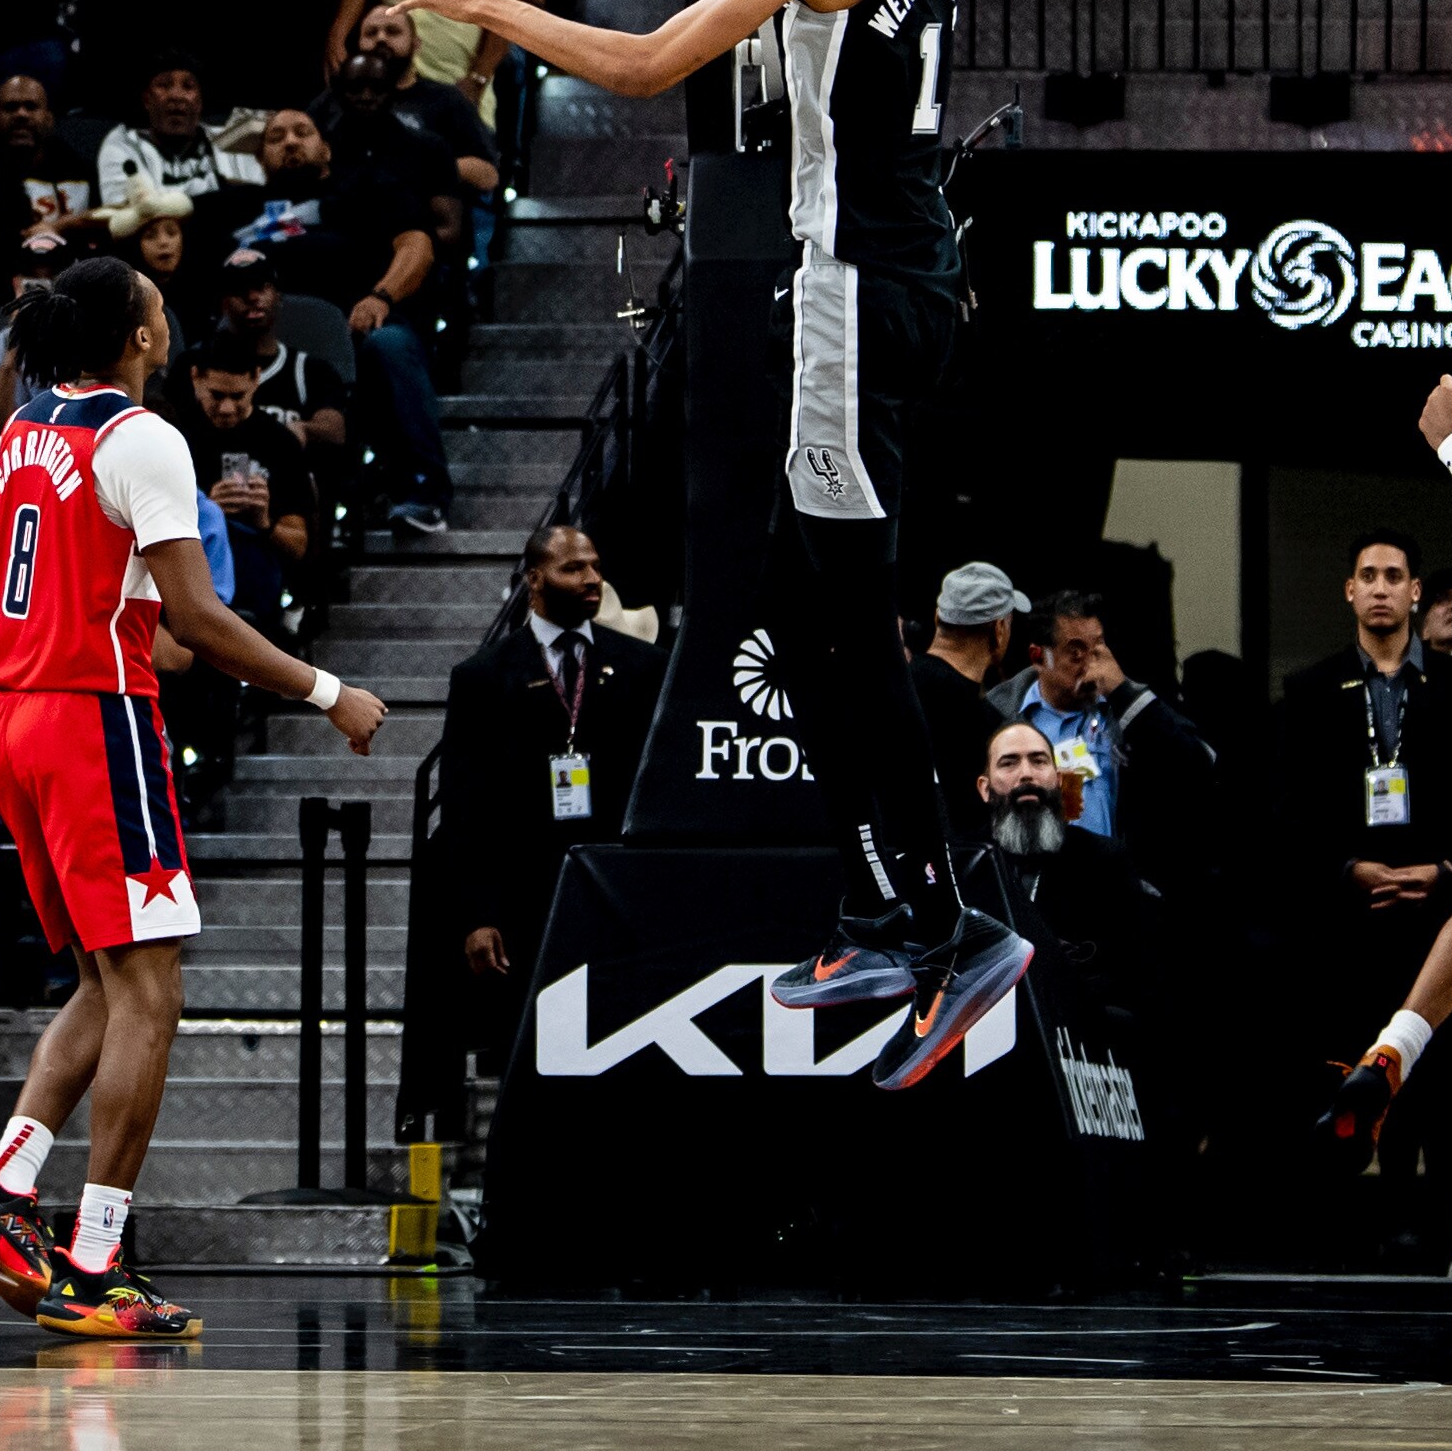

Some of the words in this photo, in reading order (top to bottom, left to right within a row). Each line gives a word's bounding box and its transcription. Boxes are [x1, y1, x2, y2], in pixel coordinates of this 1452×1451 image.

[911, 23, 942, 135] 1
[1066, 211, 1227, 240] KICKAPOO
[1032, 240, 1252, 311] LUCKY
[2, 504, 40, 620] 8
